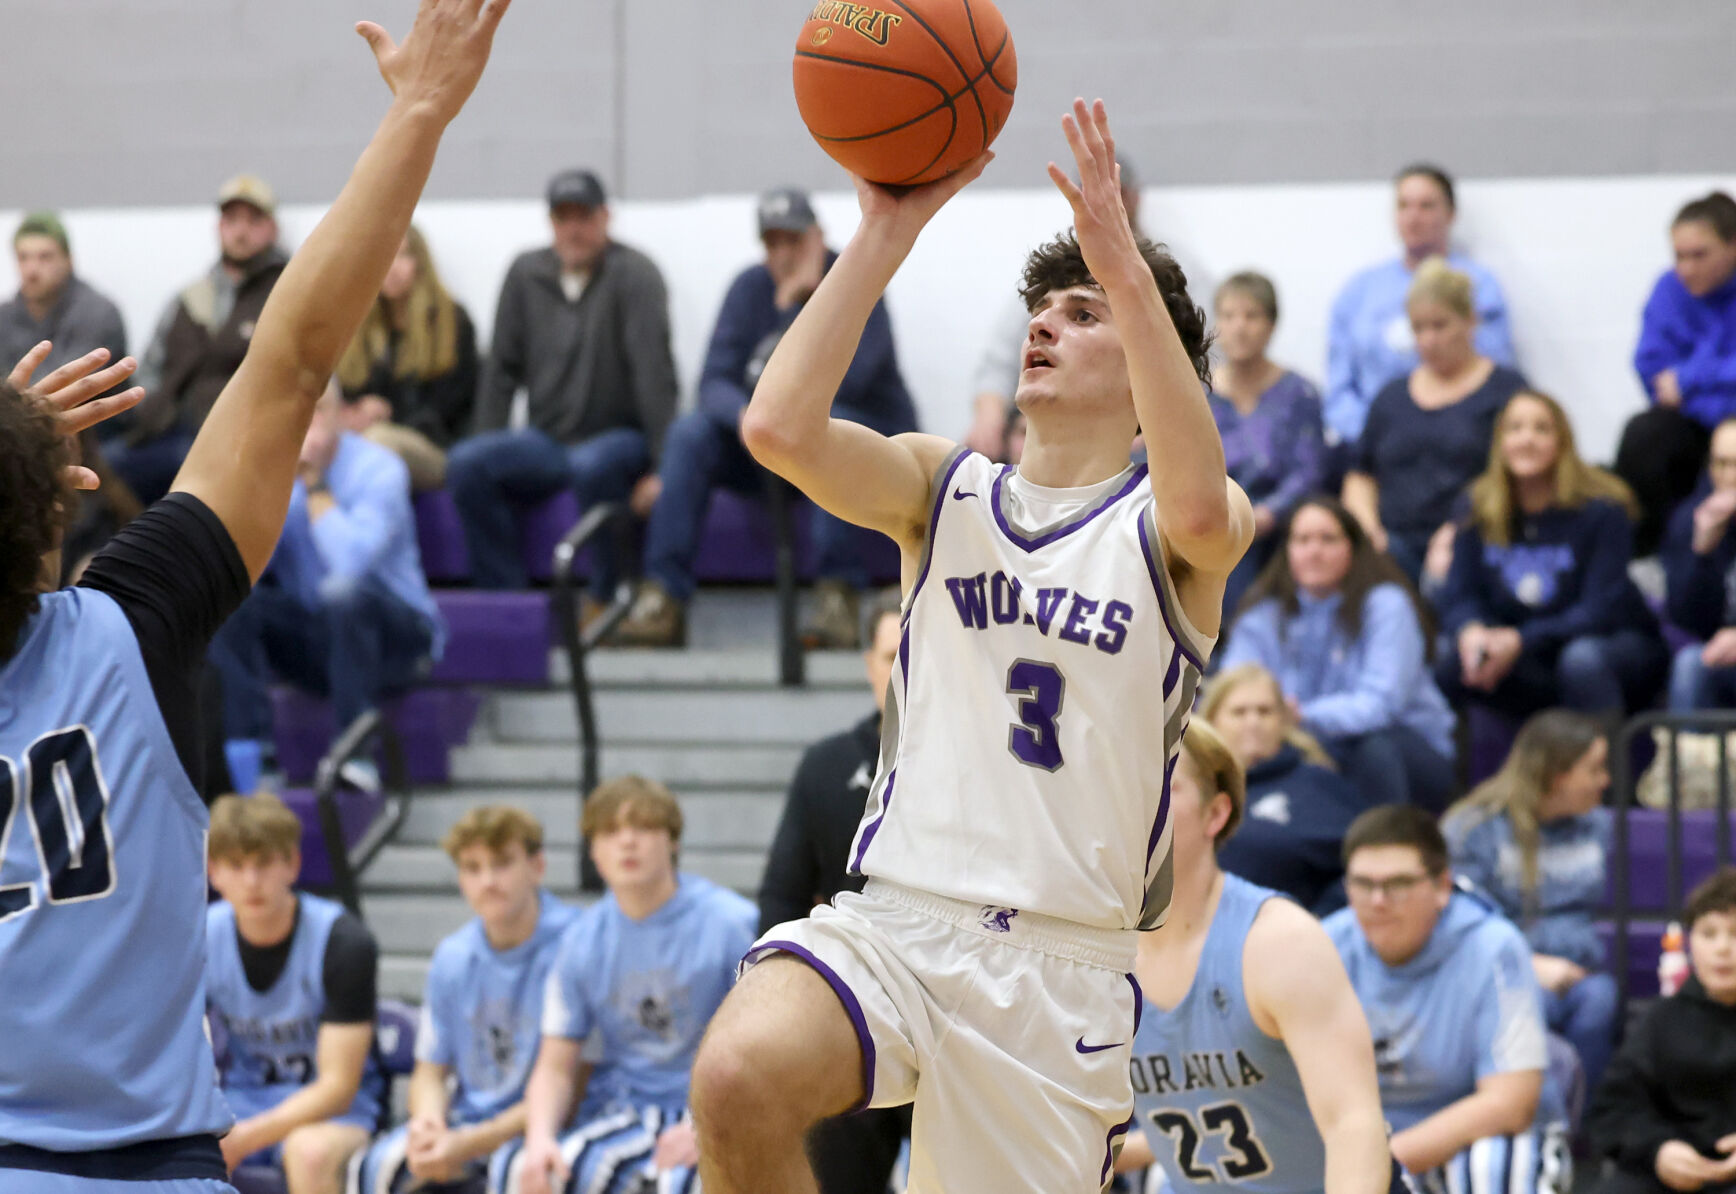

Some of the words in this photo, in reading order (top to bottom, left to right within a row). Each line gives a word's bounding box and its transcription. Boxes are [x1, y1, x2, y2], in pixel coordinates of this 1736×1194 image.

[808, 1, 902, 46] SPALD
[1005, 657, 1066, 773] 3
[1129, 1050, 1264, 1094] ORAVIA
[1149, 1100, 1274, 1183] 23
